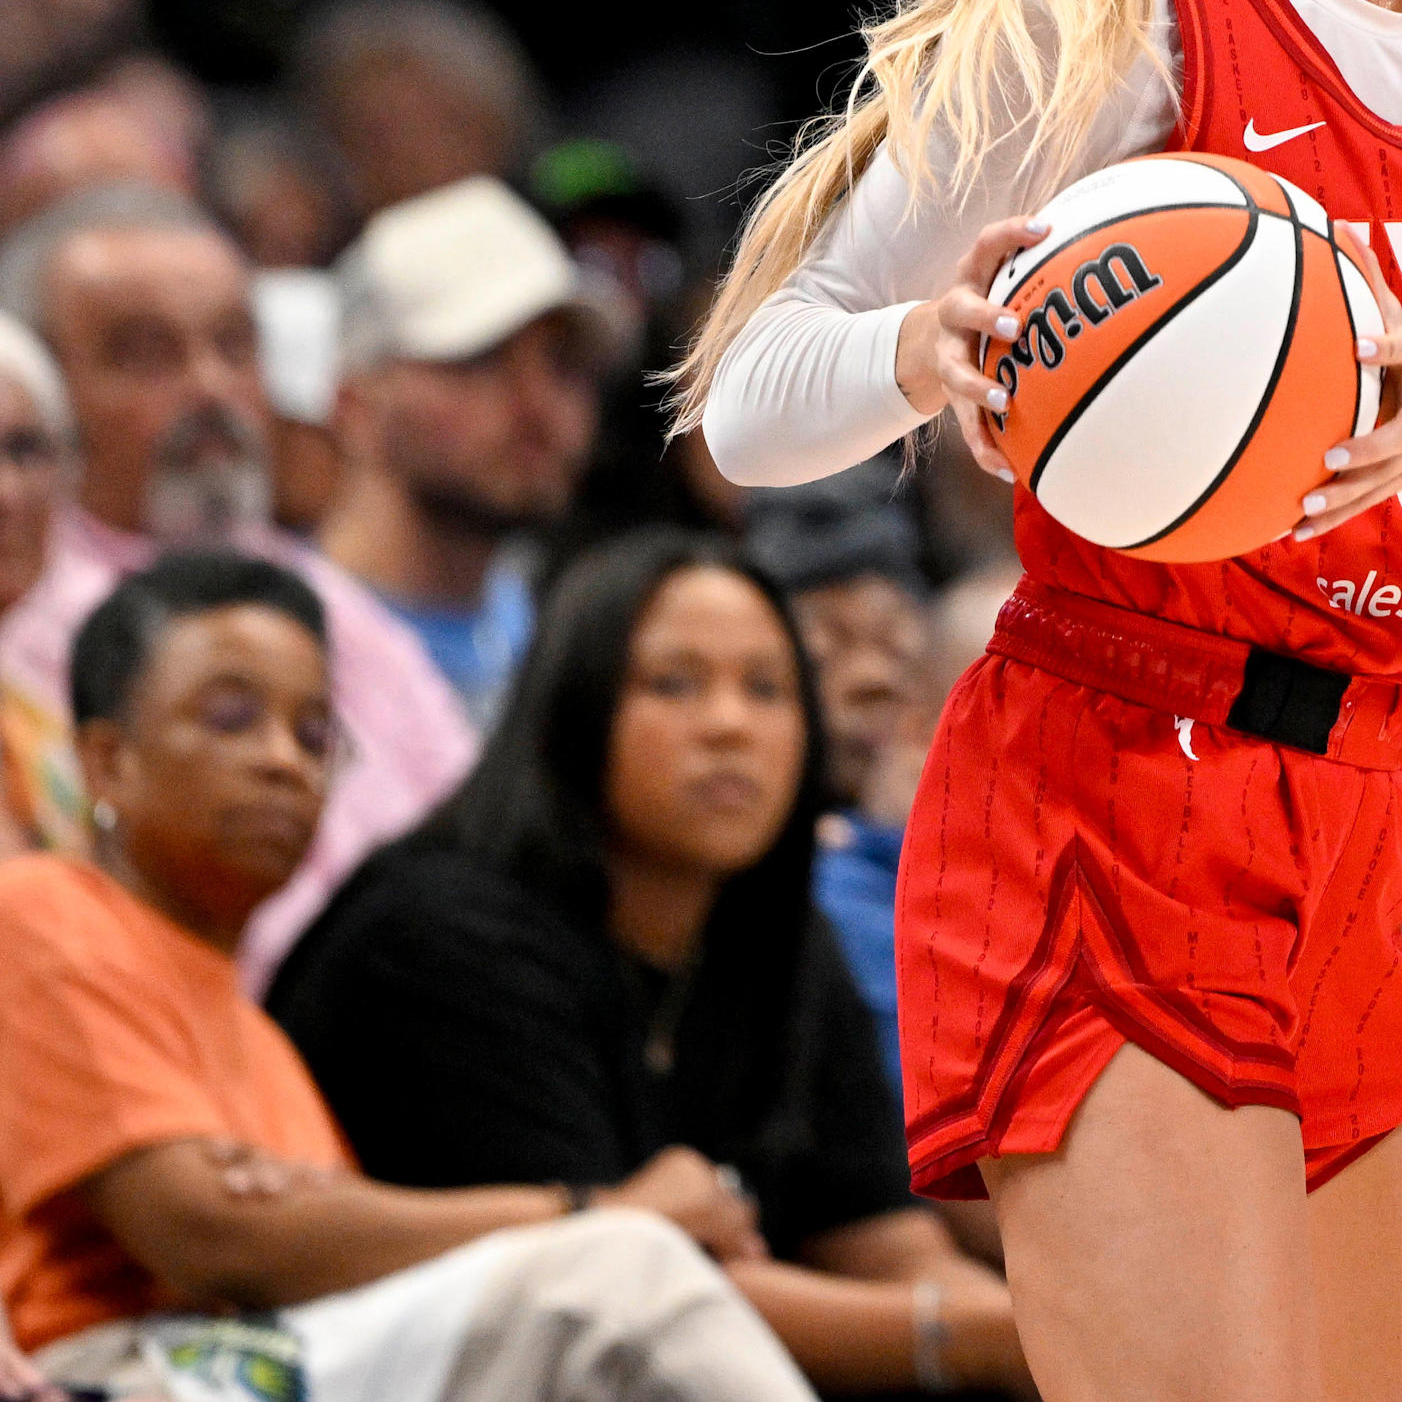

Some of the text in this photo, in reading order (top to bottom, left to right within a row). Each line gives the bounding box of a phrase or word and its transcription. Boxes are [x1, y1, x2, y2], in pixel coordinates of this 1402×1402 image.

[991, 241, 1164, 434] Wilso
[1356, 828, 1387, 901] CHOSE
[1294, 944, 1341, 1061] BASKETBAL
